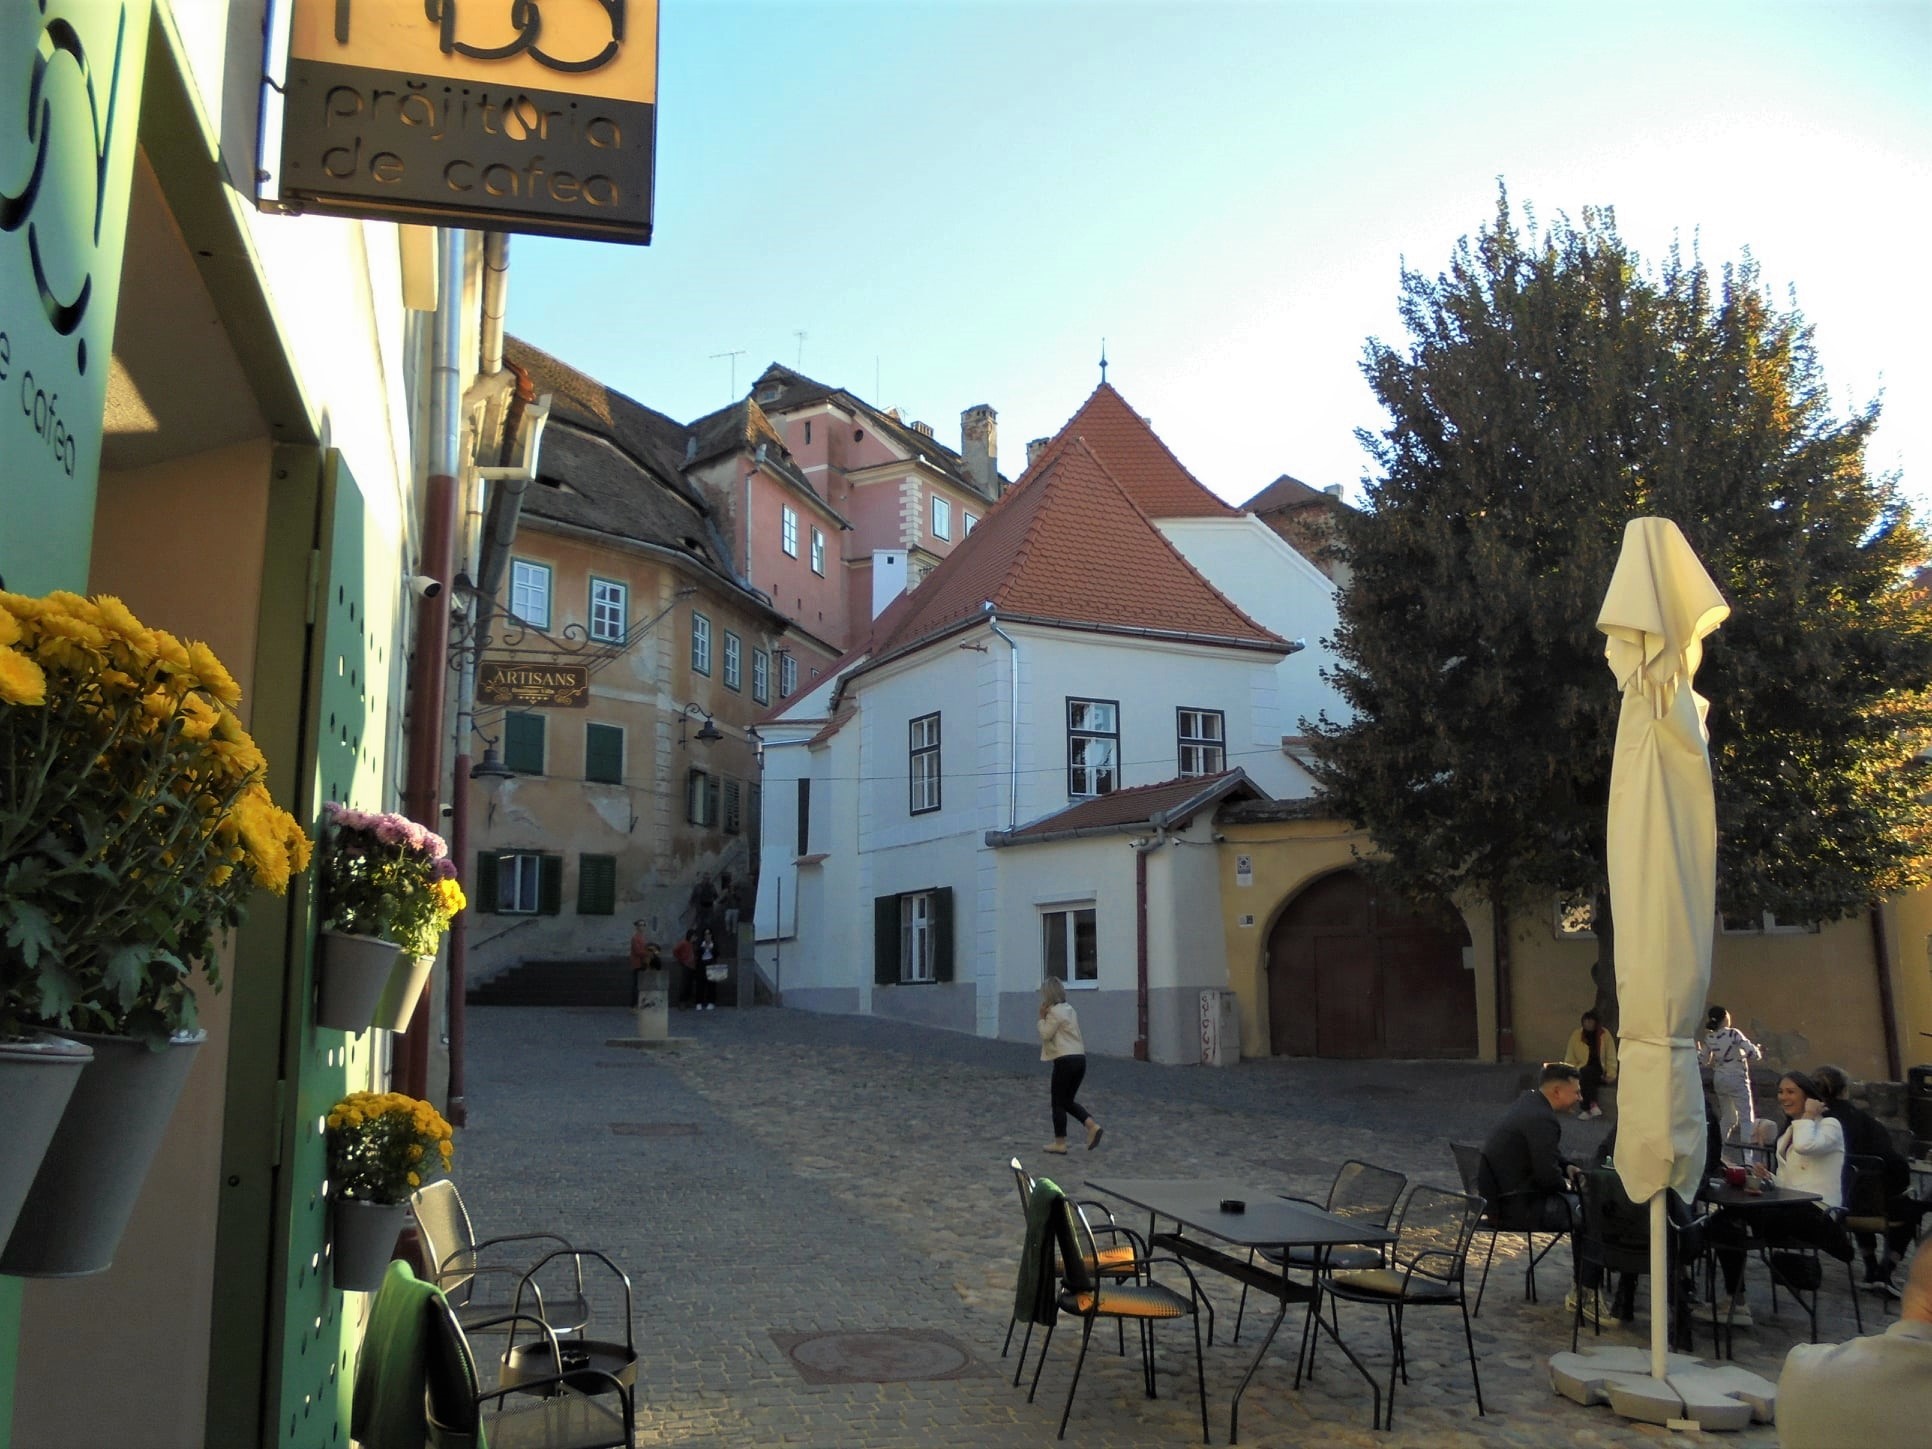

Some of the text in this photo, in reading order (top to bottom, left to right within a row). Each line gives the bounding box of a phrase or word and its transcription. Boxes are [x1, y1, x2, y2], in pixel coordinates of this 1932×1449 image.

[321, 136, 619, 207] de cafea
[22, 370, 76, 480] cafea
[495, 670, 576, 686] ARTISANS
